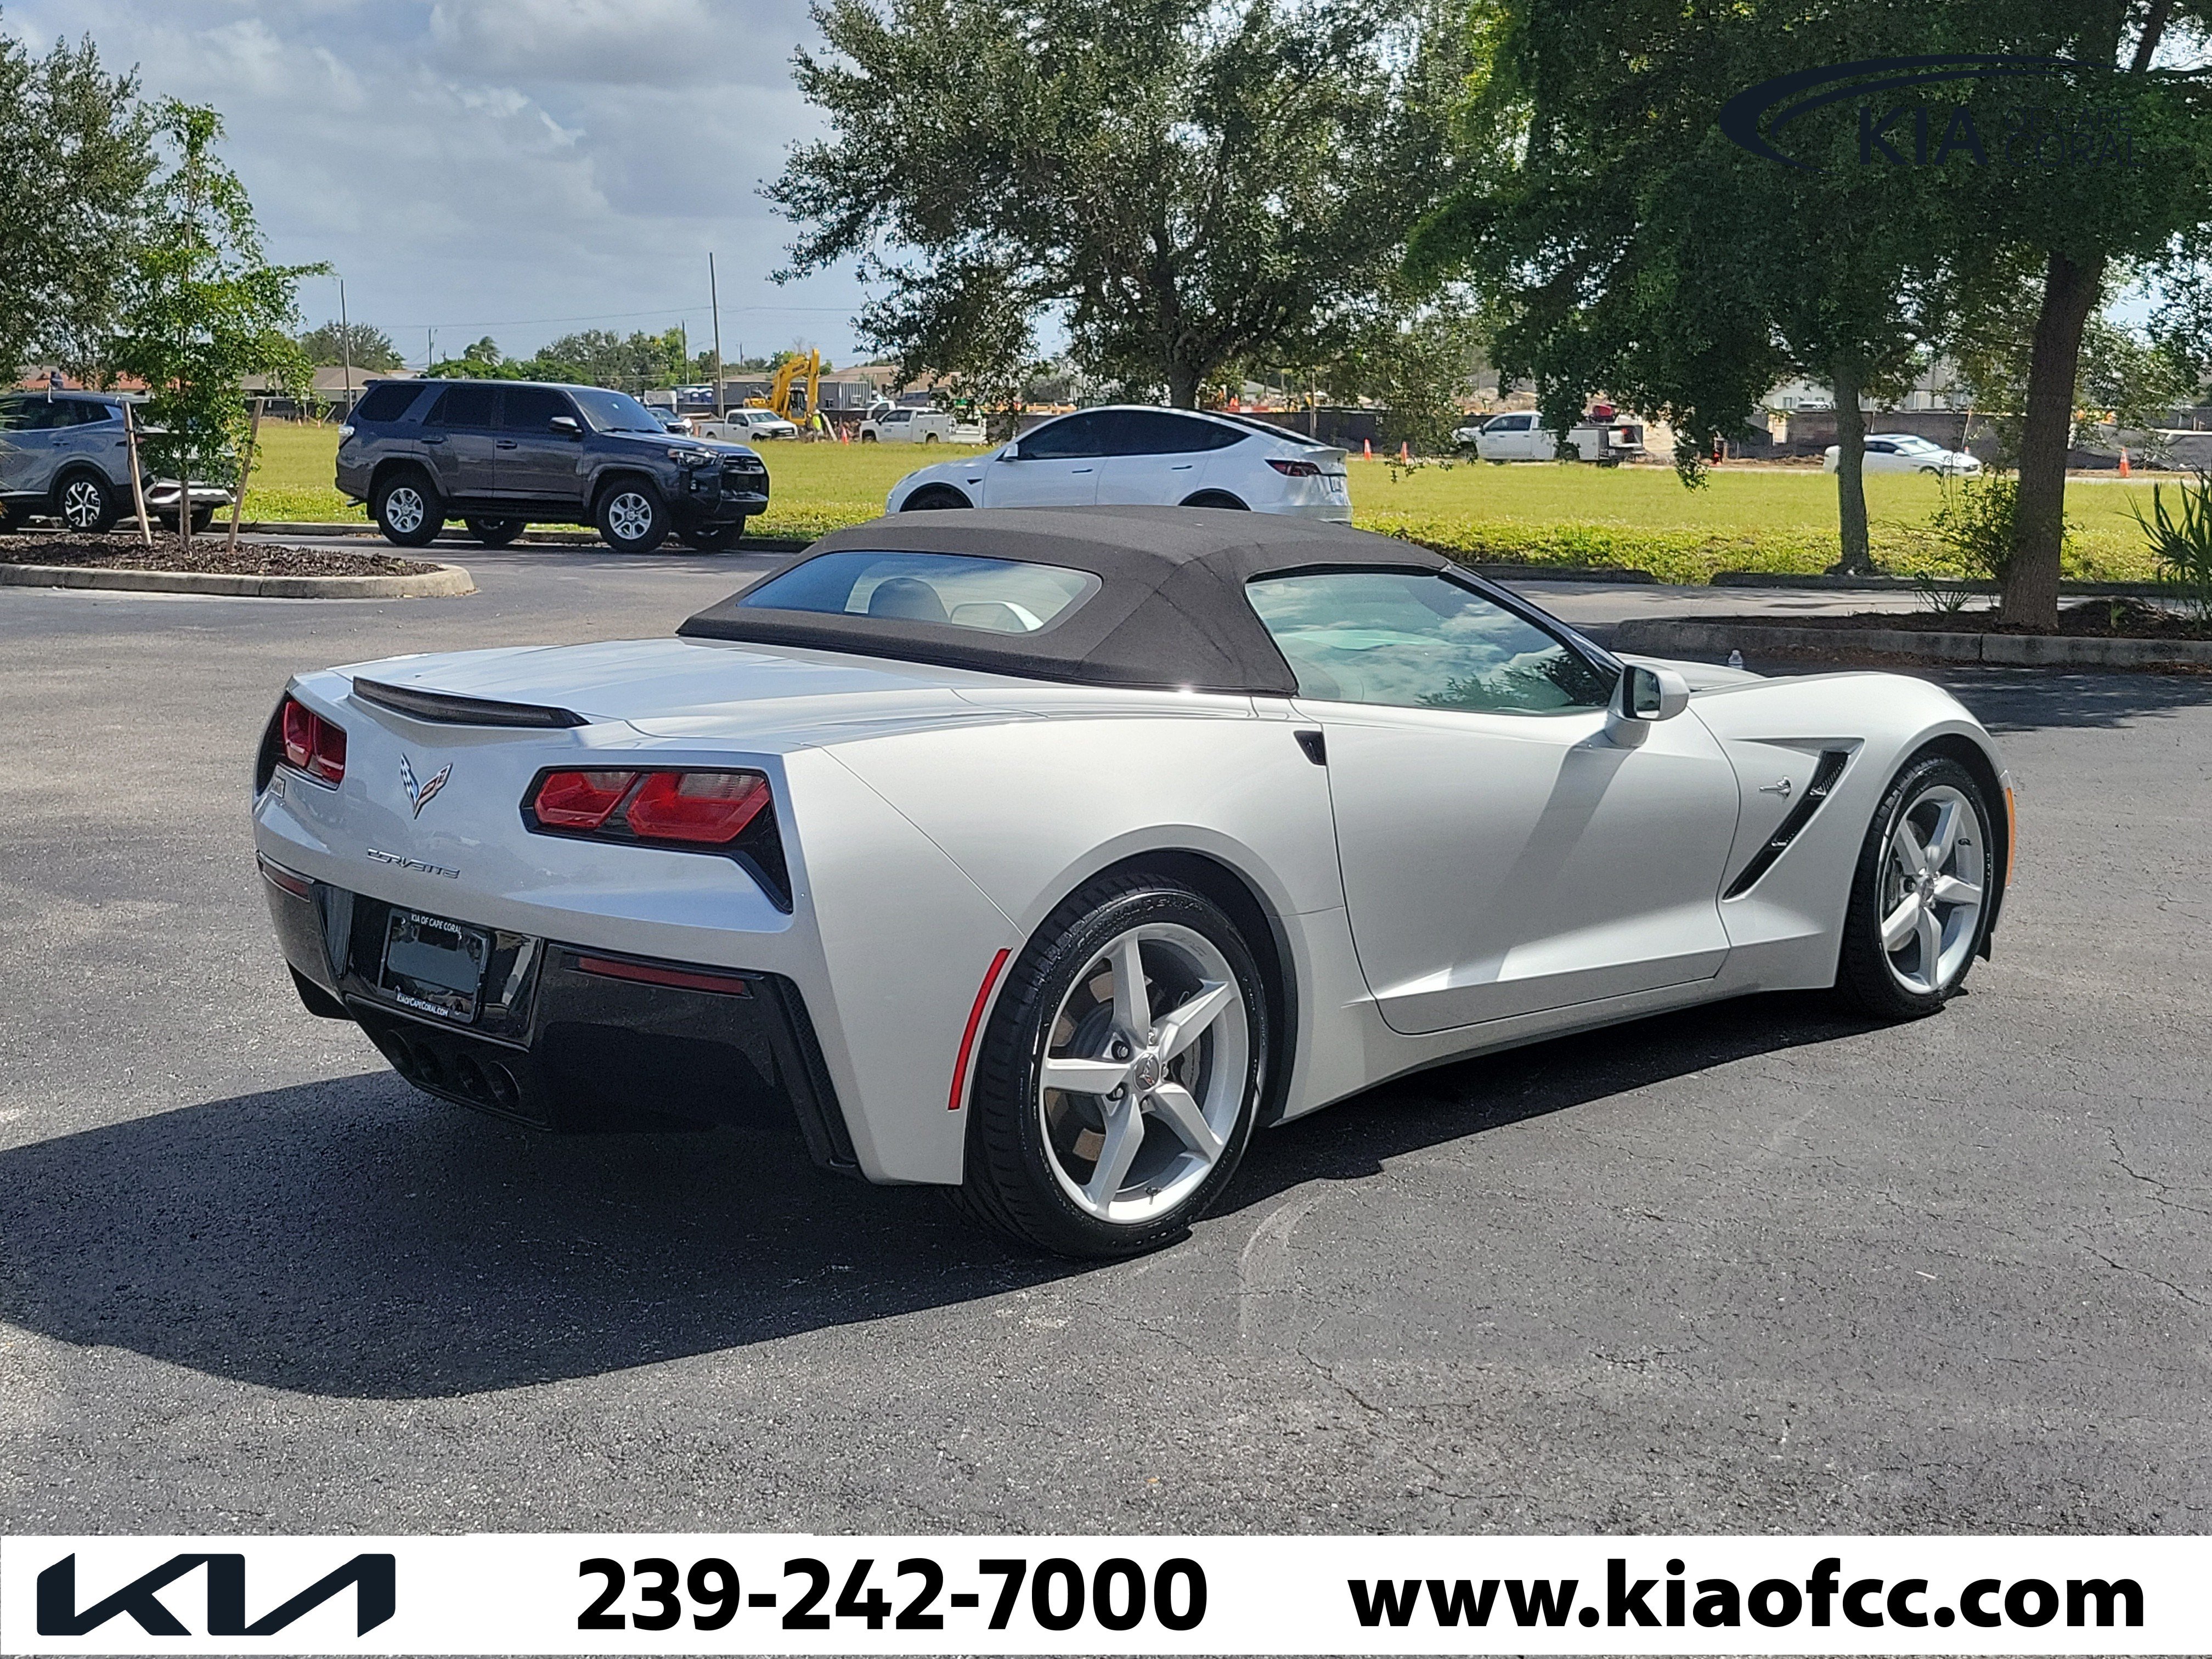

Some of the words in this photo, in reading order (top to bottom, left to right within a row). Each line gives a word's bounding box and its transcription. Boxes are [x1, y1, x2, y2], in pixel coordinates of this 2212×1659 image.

[411, 913, 420, 922] KIA
[420, 916, 429, 925] OF
[429, 918, 443, 929] CAPE
